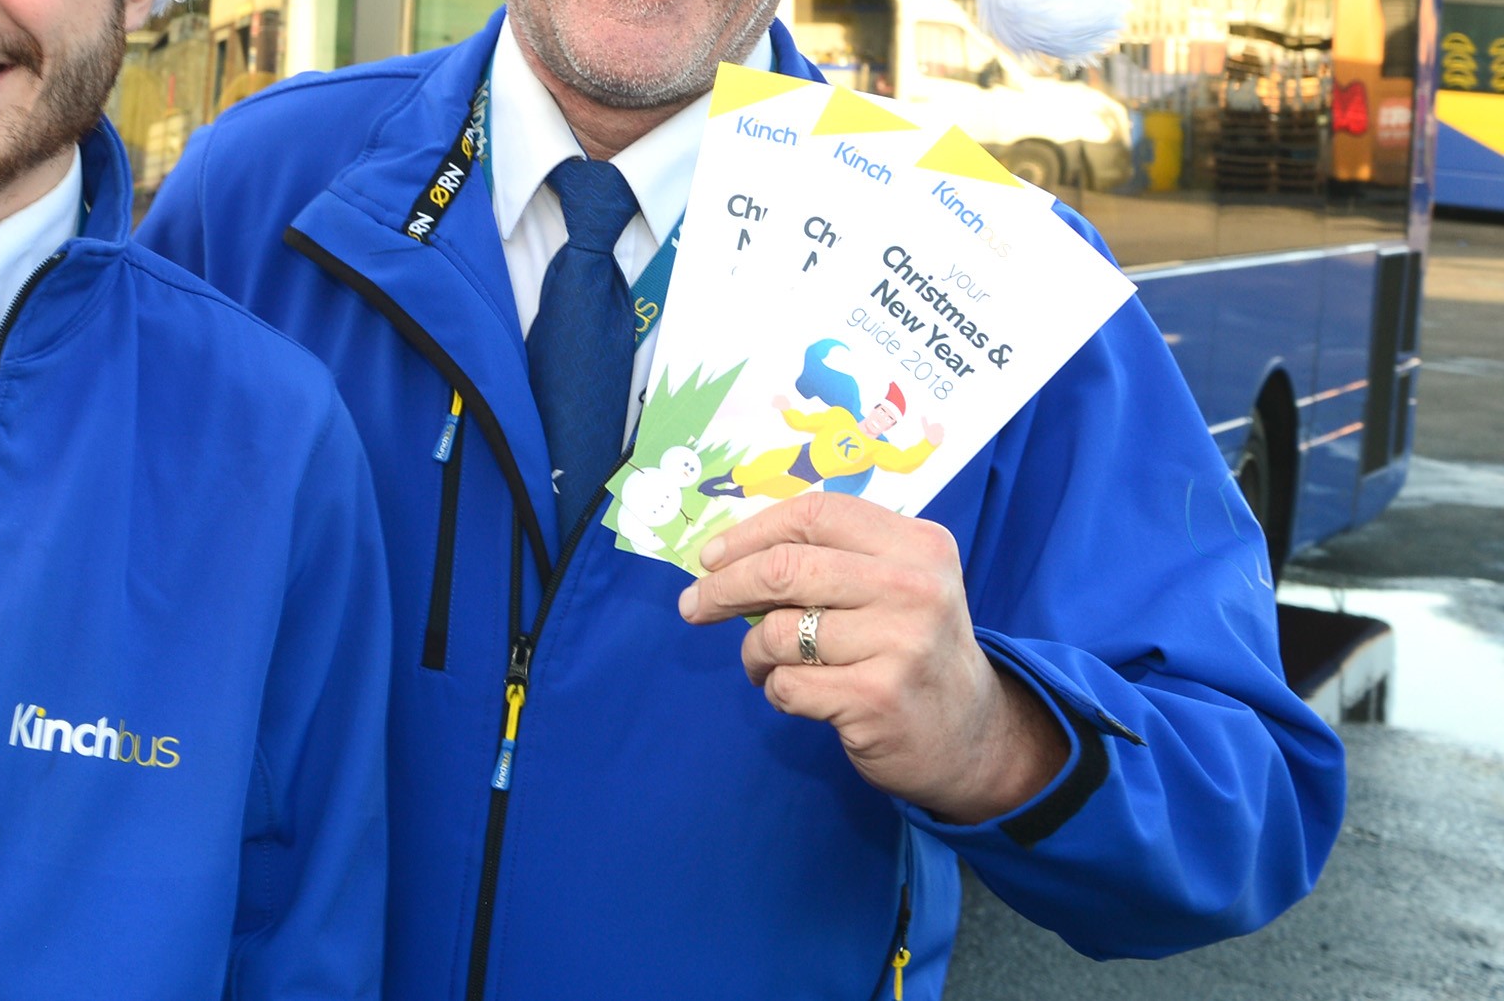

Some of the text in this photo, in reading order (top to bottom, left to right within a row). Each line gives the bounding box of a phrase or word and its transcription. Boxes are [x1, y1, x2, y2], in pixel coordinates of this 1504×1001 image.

[736, 115, 798, 147] Kinch
[833, 141, 893, 186] Kinch
[882, 245, 1014, 371] Christmas &
[941, 263, 992, 304] your
[846, 306, 955, 401] guide 2018
[870, 278, 976, 379] New Year
[7, 702, 181, 769] Kinchbus
